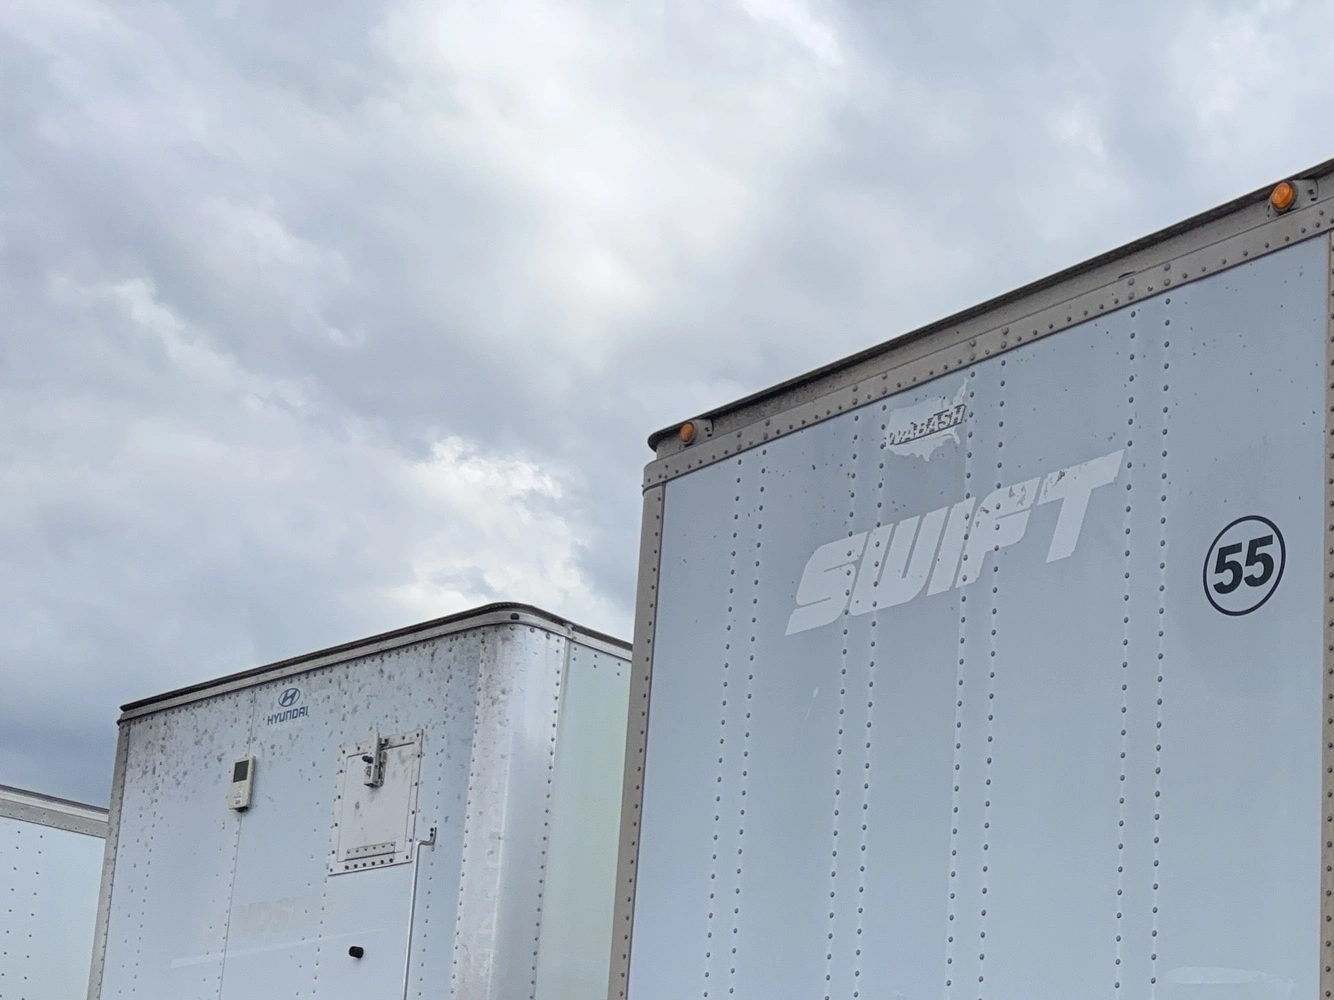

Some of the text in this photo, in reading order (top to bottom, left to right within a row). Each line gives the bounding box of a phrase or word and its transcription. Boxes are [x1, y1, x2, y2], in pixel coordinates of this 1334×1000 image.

[784, 448, 1127, 637] SWIFT
[1213, 534, 1275, 595] 55
[267, 706, 309, 726] HYUNDAI
